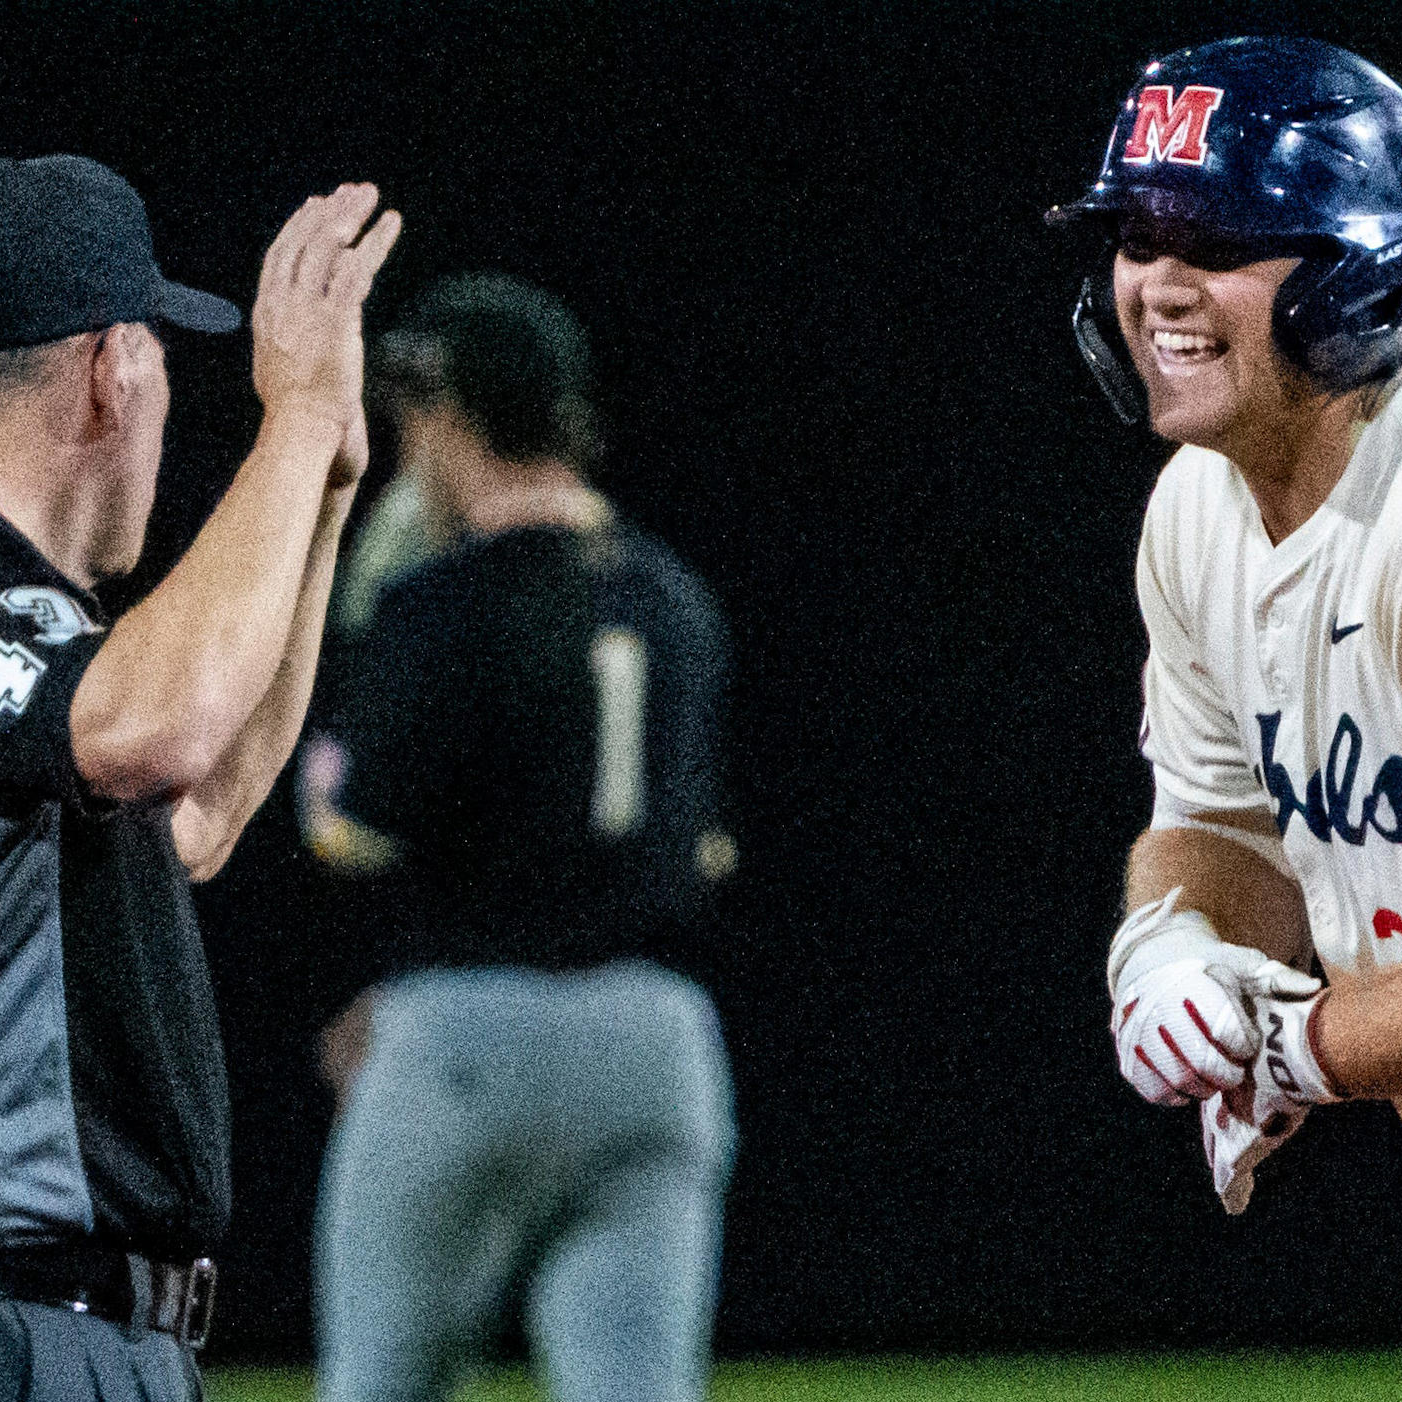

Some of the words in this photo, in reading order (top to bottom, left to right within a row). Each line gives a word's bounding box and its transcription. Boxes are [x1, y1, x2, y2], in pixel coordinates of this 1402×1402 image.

[1123, 84, 1225, 167] M
[591, 624, 649, 838] 1
[1265, 1011, 1302, 1094] ON
